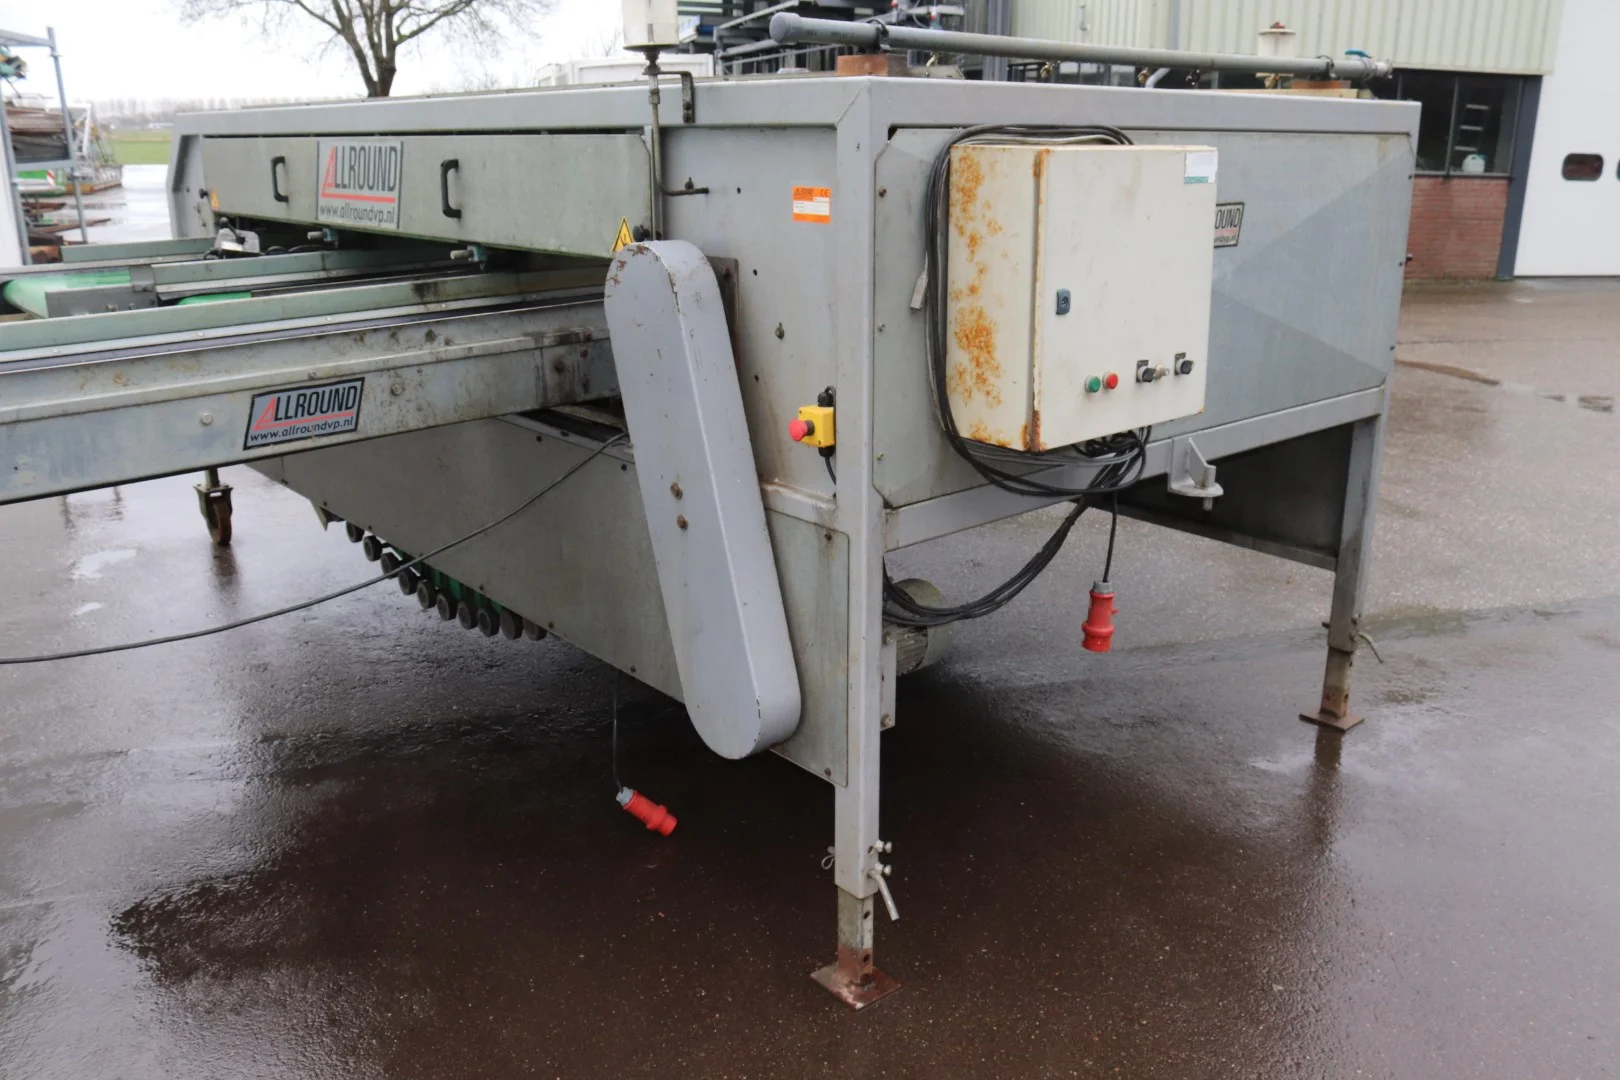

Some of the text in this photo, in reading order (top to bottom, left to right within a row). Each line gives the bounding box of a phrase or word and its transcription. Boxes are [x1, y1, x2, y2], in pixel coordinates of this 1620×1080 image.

[321, 144, 398, 197] ALLROUND
[320, 202, 396, 223] www.allroundvp.nl
[1215, 208, 1241, 229] OUND
[252, 385, 358, 431] ALLROUND
[250, 417, 354, 441] www.allroundvp.nl
